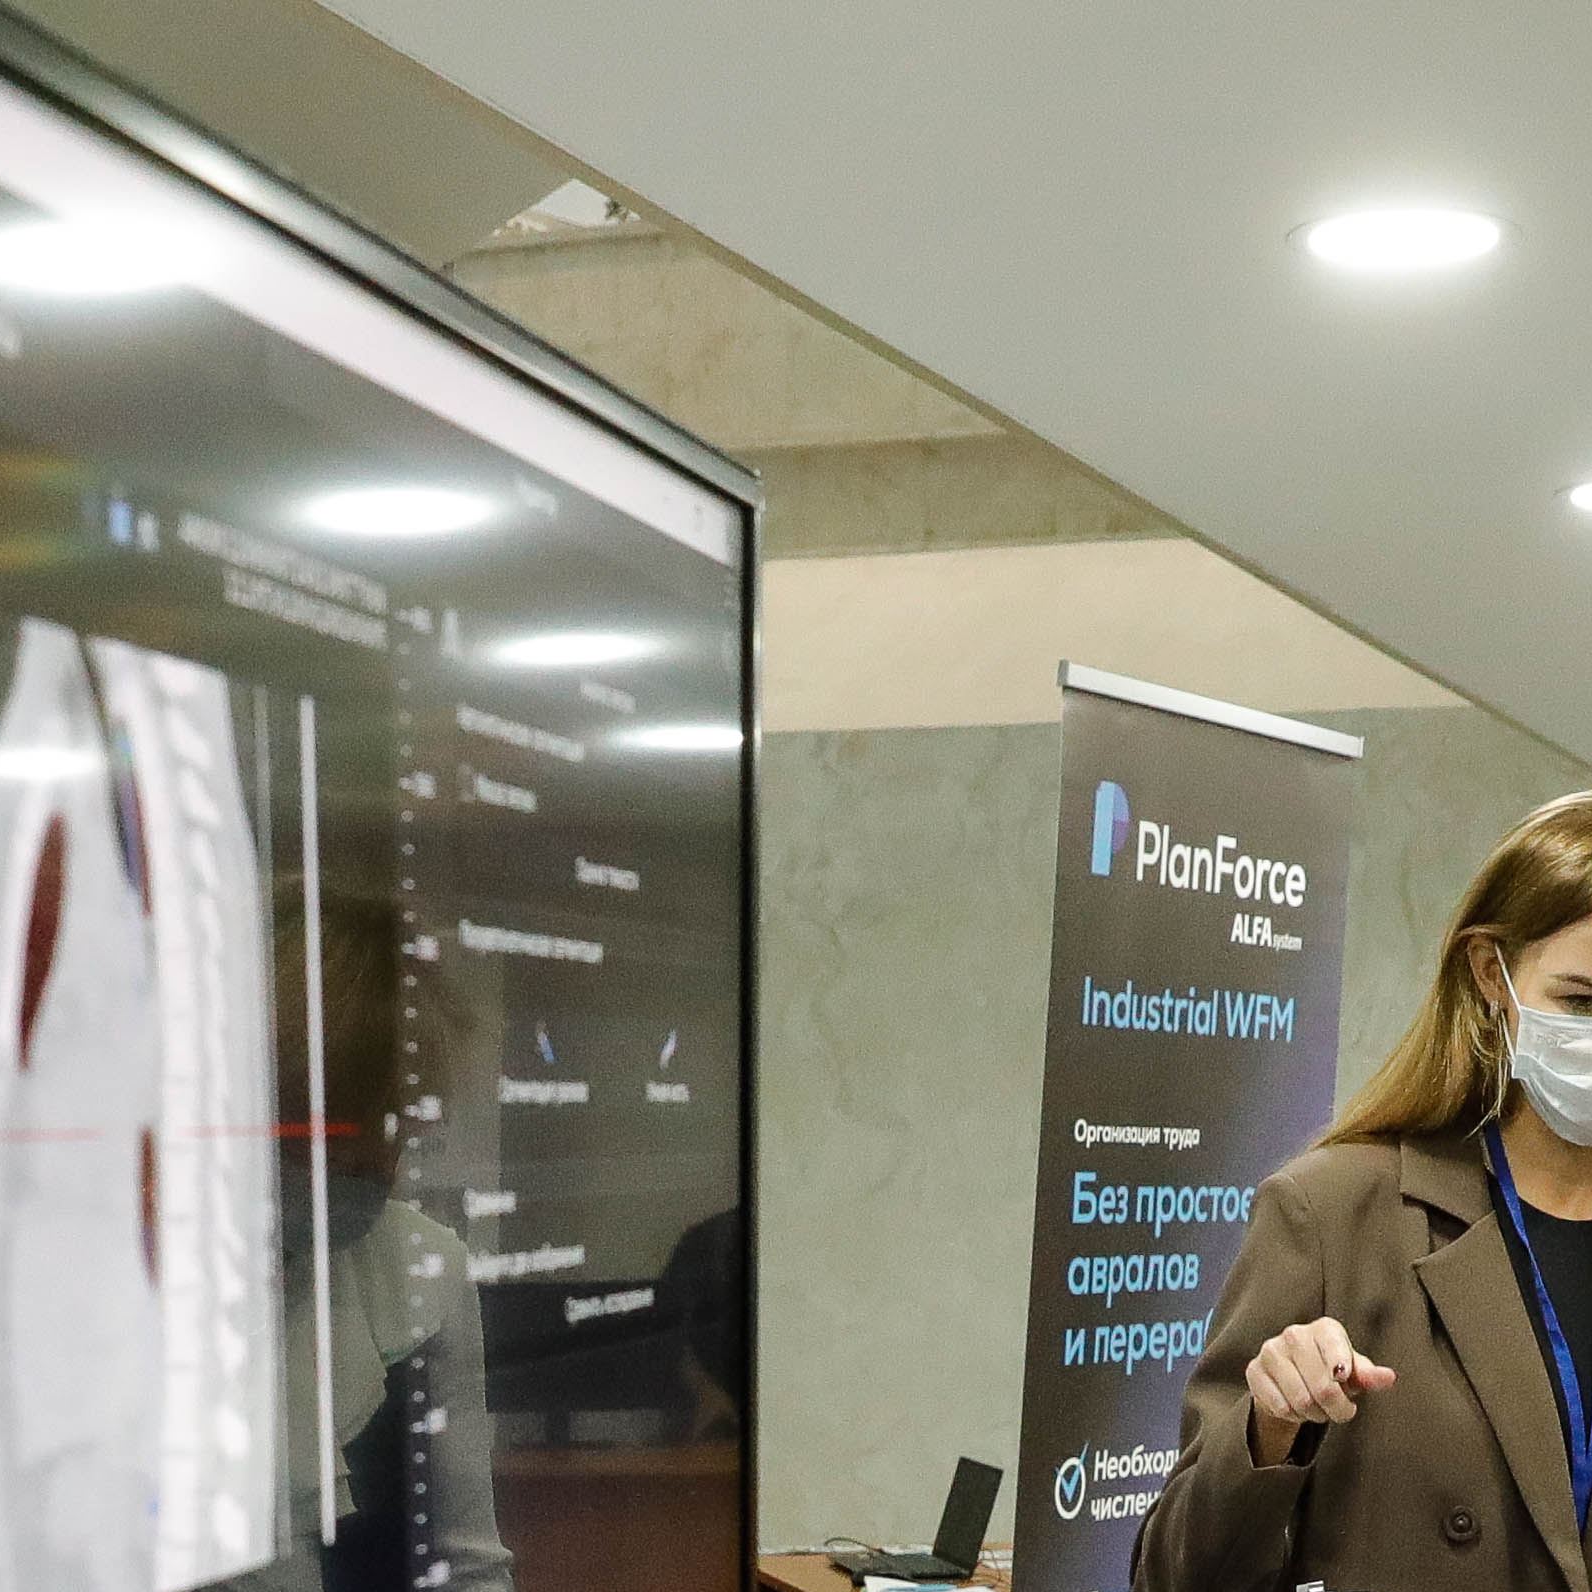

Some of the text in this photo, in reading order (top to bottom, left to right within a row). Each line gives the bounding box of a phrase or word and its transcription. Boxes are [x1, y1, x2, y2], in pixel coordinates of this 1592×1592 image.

[1136, 820, 1307, 907] PlanForce
[1082, 976, 1295, 1043] Industrial WFM
[1074, 1118, 1200, 1150] Организация труда
[1072, 1171, 1129, 1224] Без
[1068, 1253, 1200, 1308] авралов
[1064, 1307, 1214, 1375] и перера
[1093, 1444, 1180, 1482] Необход
